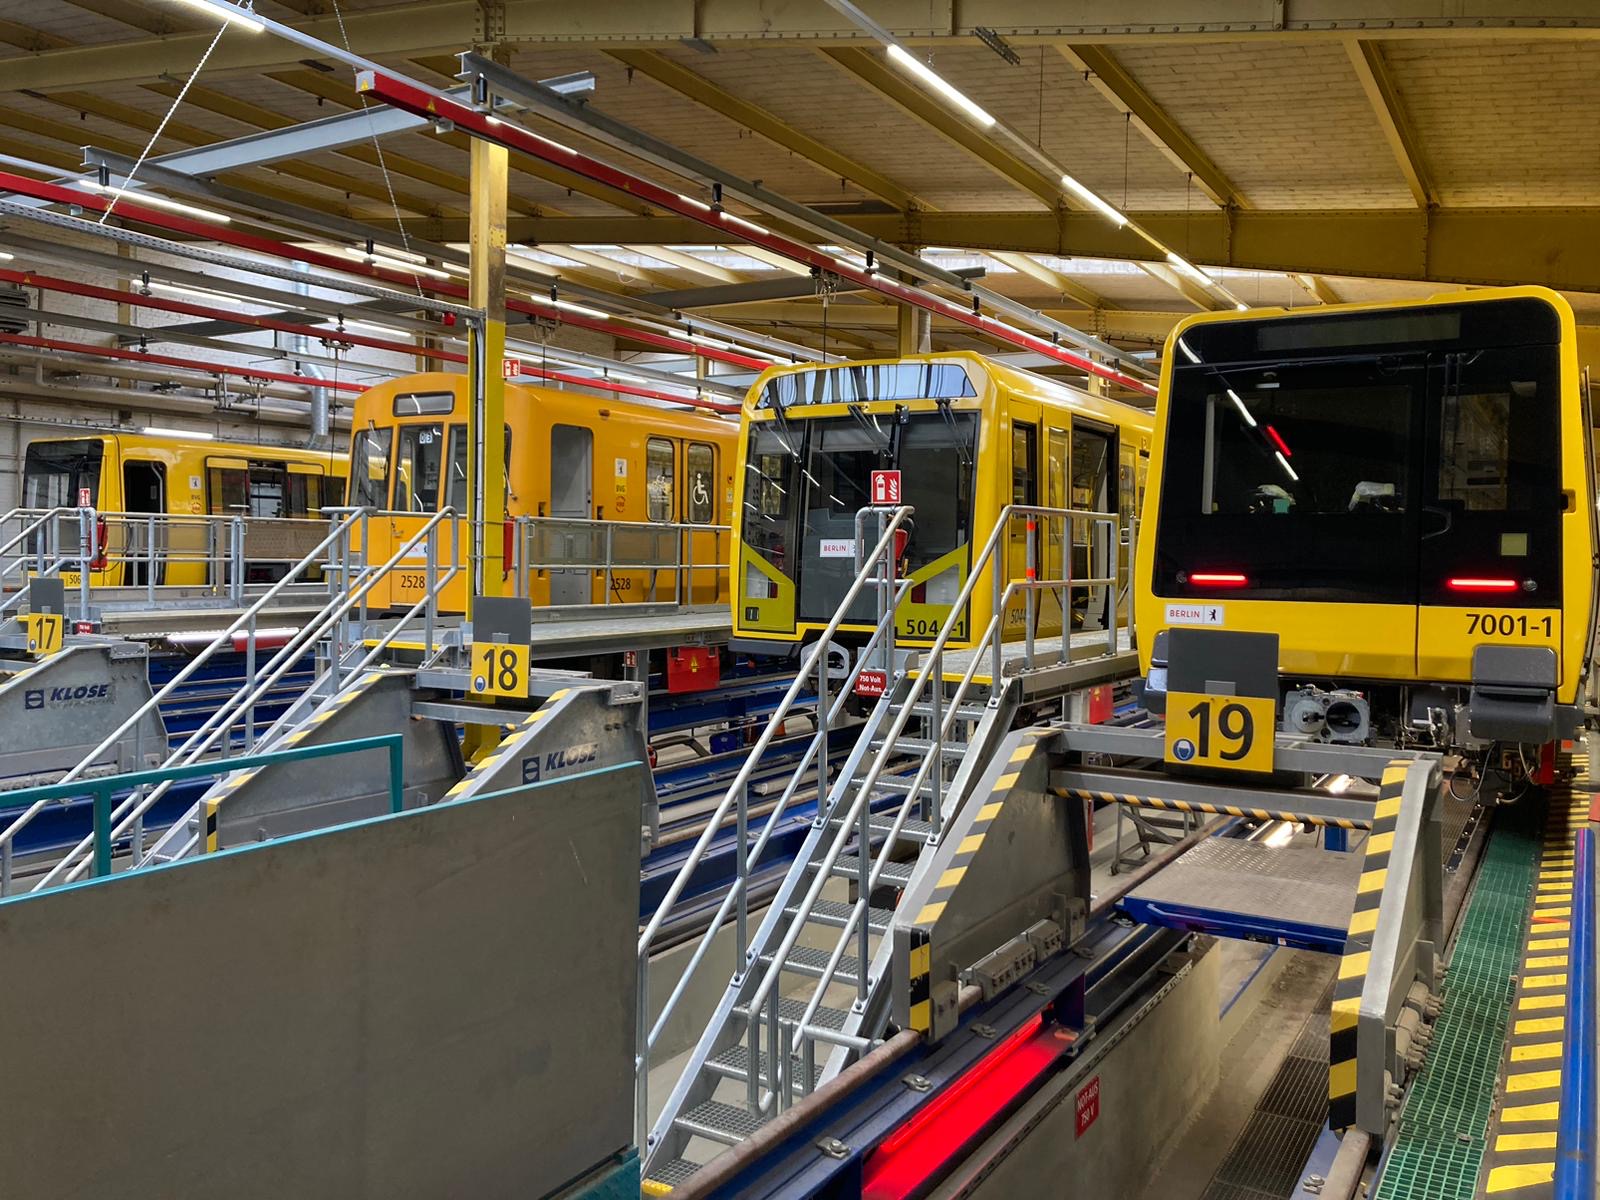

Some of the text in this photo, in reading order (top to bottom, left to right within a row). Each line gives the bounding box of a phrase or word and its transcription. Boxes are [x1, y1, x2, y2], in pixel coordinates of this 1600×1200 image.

[823, 544, 847, 552] BERLIN
[400, 574, 426, 589] 2528
[610, 577, 631, 591] 2528
[1169, 609, 1201, 618] BERLIN
[36, 617, 56, 650] 17
[906, 618, 964, 636] 504-1
[1465, 613, 1552, 638] 7001-1
[483, 649, 518, 691] 18
[50, 684, 109, 702] KLOSE
[1188, 701, 1254, 761] 19
[545, 744, 598, 771] KLOSE
